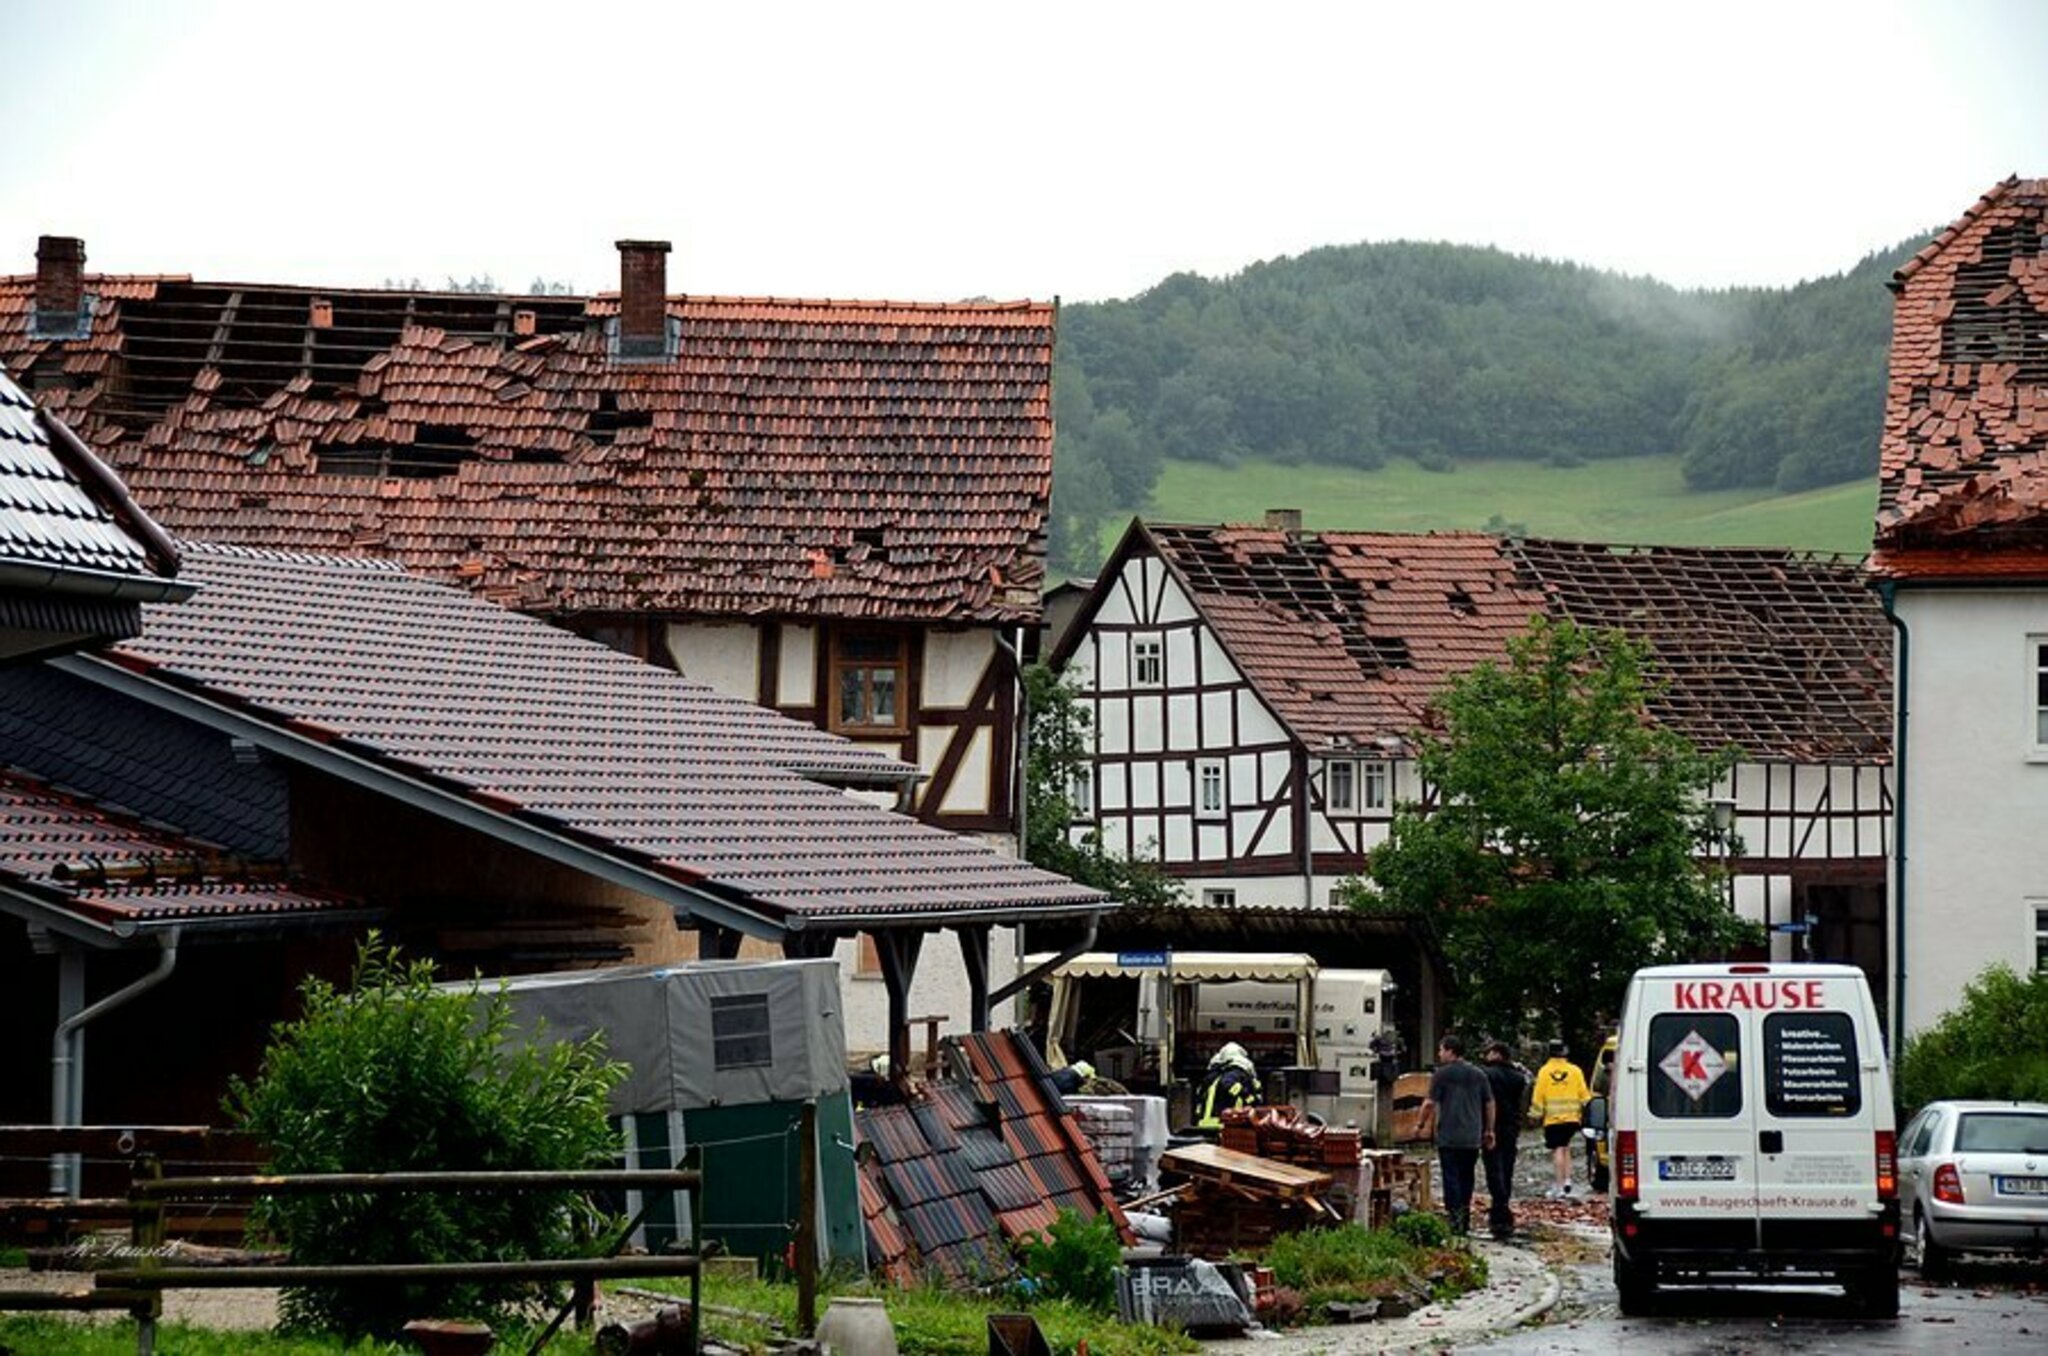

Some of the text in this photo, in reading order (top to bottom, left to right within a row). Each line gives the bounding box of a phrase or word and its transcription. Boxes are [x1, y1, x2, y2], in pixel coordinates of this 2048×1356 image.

[1674, 981, 1825, 1009] KRAUSE
[1781, 1041, 1841, 1050] Malerarbeiten
[1781, 1054, 1847, 1063] Fliesenarbeiten
[1681, 1050, 1708, 1080] K
[1782, 1067, 1837, 1076] Putzarbeiten
[1783, 1080, 1849, 1089] Maurerarbeiten
[1659, 1195, 1858, 1210] www.Baugeschaeft-Krause.de
